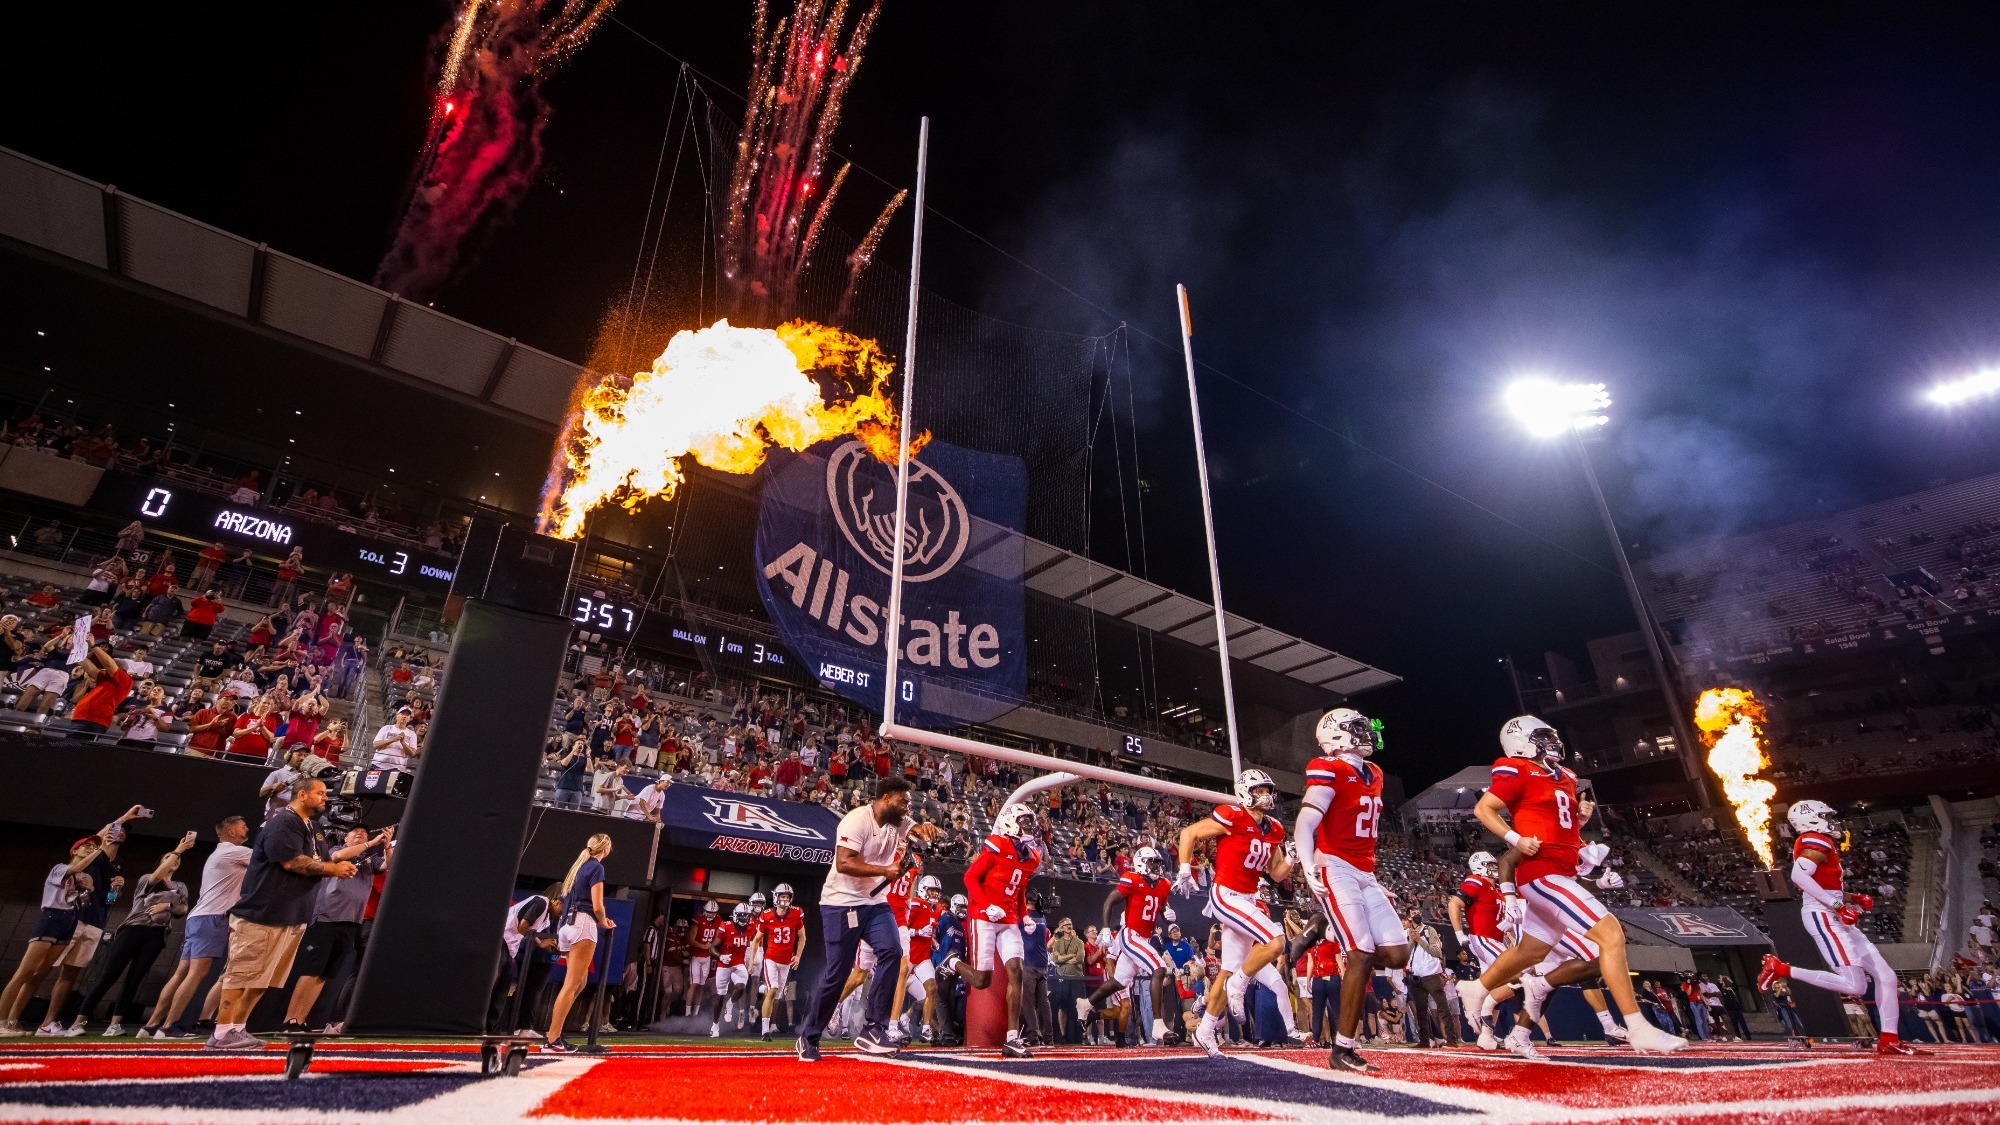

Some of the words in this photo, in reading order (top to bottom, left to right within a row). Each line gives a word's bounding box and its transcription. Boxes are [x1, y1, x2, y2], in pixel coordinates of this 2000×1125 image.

[141, 487, 172, 517] 0
[214, 510, 292, 545] ARIZONA
[130, 551, 149, 563] 30
[389, 551, 408, 575] 3
[420, 565, 453, 581] DOWN
[574, 597, 634, 632] 3:57
[1906, 622, 1925, 631] Sun
[1926, 617, 1950, 629] Bowl
[672, 629, 693, 642] BALL
[692, 634, 706, 645] ON
[719, 636, 725, 653] 1
[727, 642, 743, 654] QTR
[1824, 636, 1848, 646] Salad
[1849, 631, 1871, 642] Bowl
[1838, 641, 1859, 650] 1949
[753, 643, 764, 664] 3
[819, 662, 854, 684] WEBER
[856, 672, 870, 688] ST
[902, 680, 914, 701] 0
[1126, 735, 1142, 754] 25
[1355, 795, 1383, 838] 26
[1554, 789, 1572, 830] 8
[709, 835, 781, 858] ARIZONA
[780, 843, 835, 864] FOOTB
[1243, 838, 1272, 872] 80
[1004, 868, 1023, 896] 9
[1142, 895, 1159, 922] 21
[773, 926, 791, 944] 33
